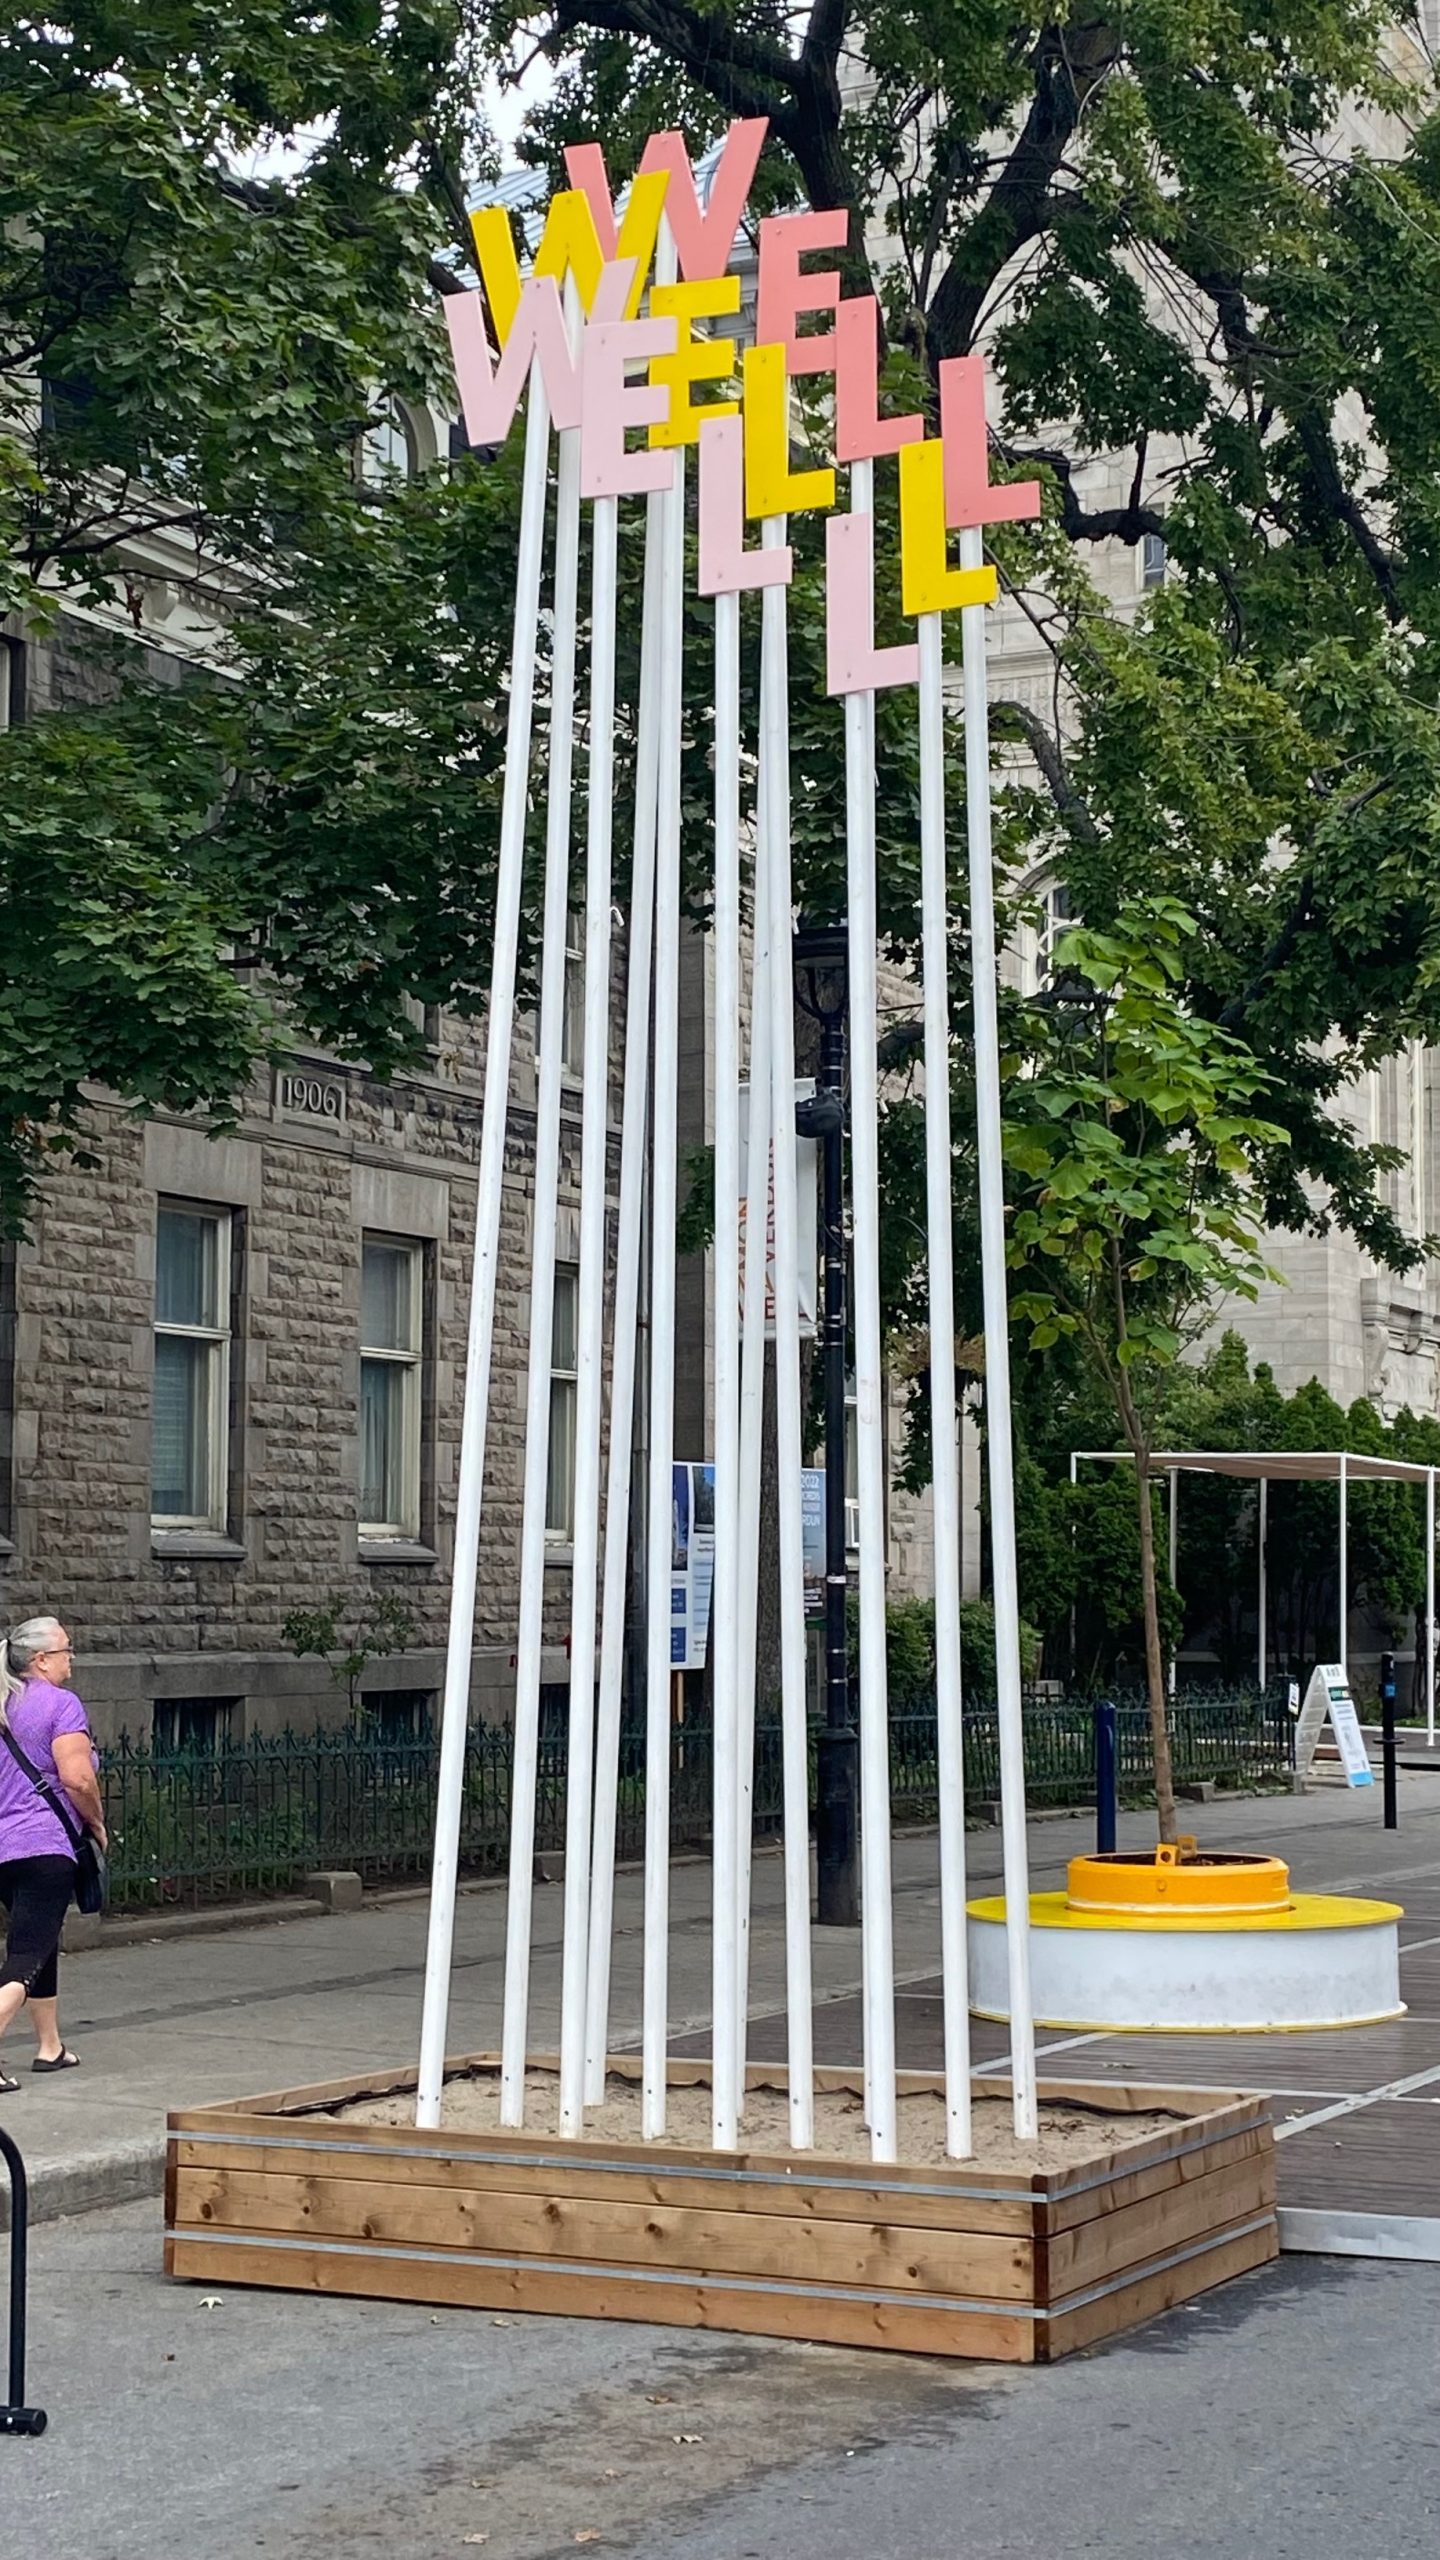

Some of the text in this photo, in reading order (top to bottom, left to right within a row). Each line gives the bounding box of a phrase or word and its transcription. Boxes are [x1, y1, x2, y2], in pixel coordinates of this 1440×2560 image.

[442, 257, 919, 696] WELL
[469, 169, 997, 616] WELL
[563, 117, 1041, 529] WELL
[285, 1077, 336, 1116] 1906
